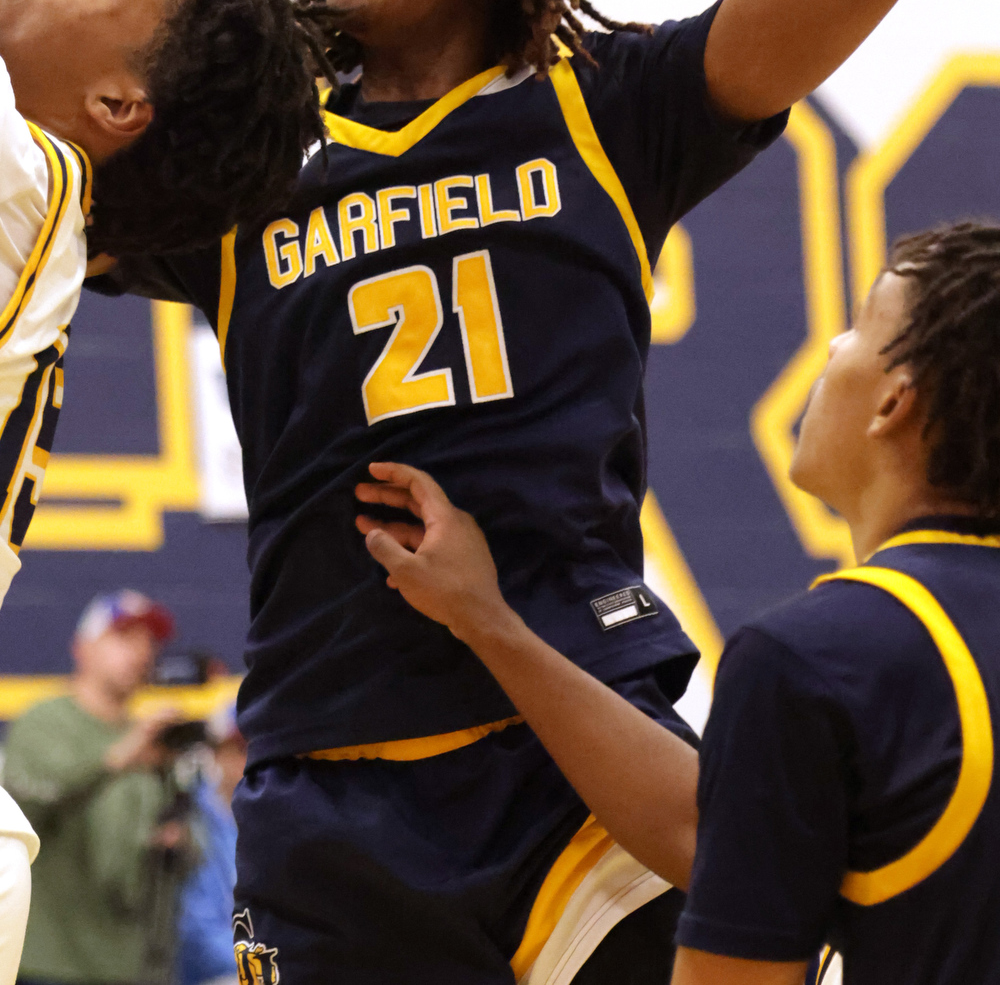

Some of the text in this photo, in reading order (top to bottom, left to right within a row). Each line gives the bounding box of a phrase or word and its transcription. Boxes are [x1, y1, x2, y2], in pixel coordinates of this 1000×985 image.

[261, 157, 562, 290] GARFIELD
[347, 248, 515, 427] 21
[639, 593, 651, 608] L
